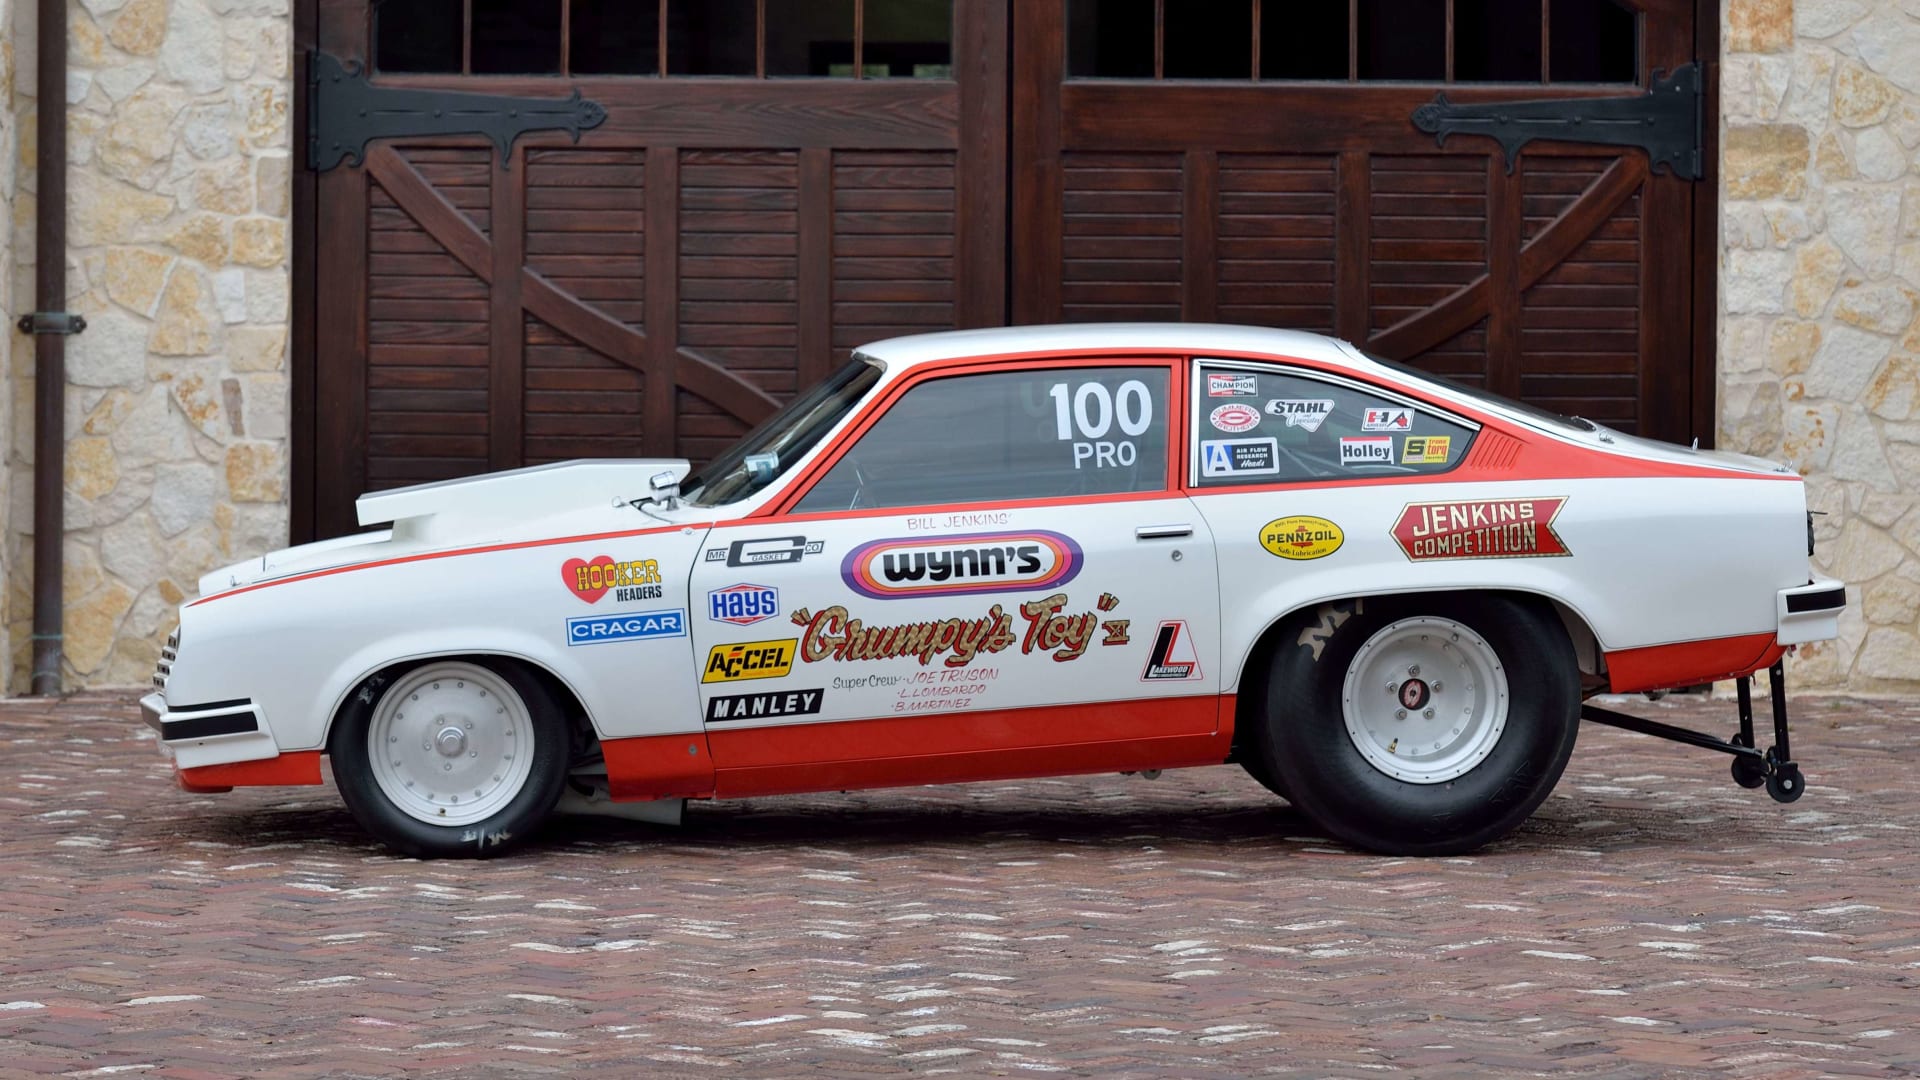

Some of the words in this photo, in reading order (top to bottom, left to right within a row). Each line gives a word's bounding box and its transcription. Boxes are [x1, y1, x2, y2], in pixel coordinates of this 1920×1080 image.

[1212, 381, 1254, 389] CHAMPION
[1050, 380, 1153, 440] 100
[1274, 401, 1328, 414] STAHL
[1073, 441, 1136, 469] PRO
[1342, 444, 1390, 460] Holley
[1406, 440, 1426, 456] S
[1240, 460, 1265, 468] Heads
[907, 517, 937, 530] BILL
[1412, 502, 1534, 537] JENKINS
[1267, 530, 1337, 544] PENNZOIL
[1414, 520, 1537, 556] COMPETITION
[709, 551, 726, 559] MR
[805, 544, 819, 552] CO
[752, 553, 785, 561] GASKET
[883, 545, 1041, 582] wynn's
[576, 558, 662, 591] HOOKER
[616, 585, 662, 602] HEADERS
[712, 590, 776, 618] Hays
[572, 617, 679, 637] CRAGAR
[1102, 619, 1130, 645] XI
[708, 646, 789, 678] ACCEL
[1148, 664, 1189, 678] LAKEWOOD
[832, 676, 869, 692] Super
[906, 671, 937, 685] JOE
[939, 668, 999, 682] TRYSON
[913, 684, 987, 698] LOMBARDO
[714, 693, 816, 718] MANLEY
[910, 698, 972, 711] MARTINEZ
